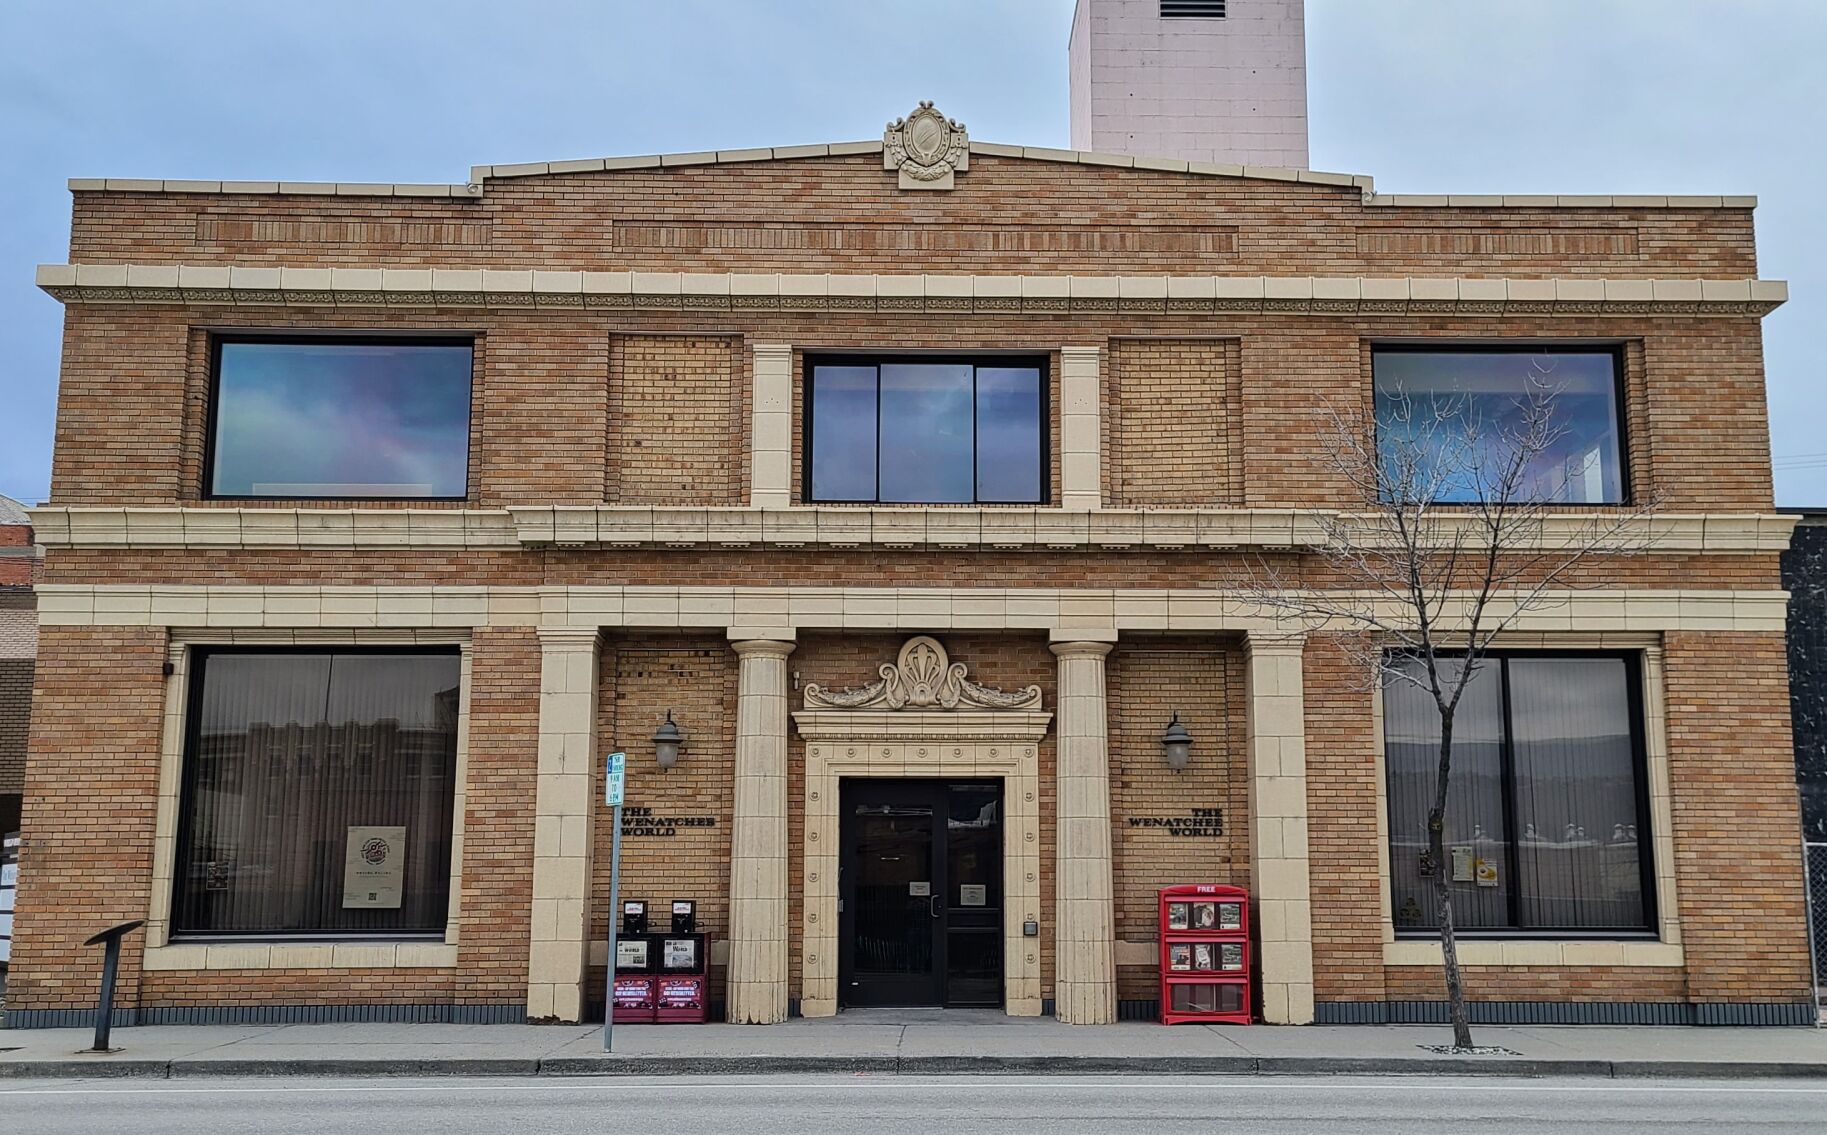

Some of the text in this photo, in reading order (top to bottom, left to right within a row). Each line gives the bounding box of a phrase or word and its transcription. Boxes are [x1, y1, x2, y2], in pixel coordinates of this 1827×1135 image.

[622, 807, 652, 816] THE
[1191, 808, 1222, 817] THE
[621, 817, 715, 826] WENATCHEE
[1128, 817, 1223, 827] WENATCHEE
[621, 827, 675, 836] WORLD
[1168, 828, 1223, 836] WORLD
